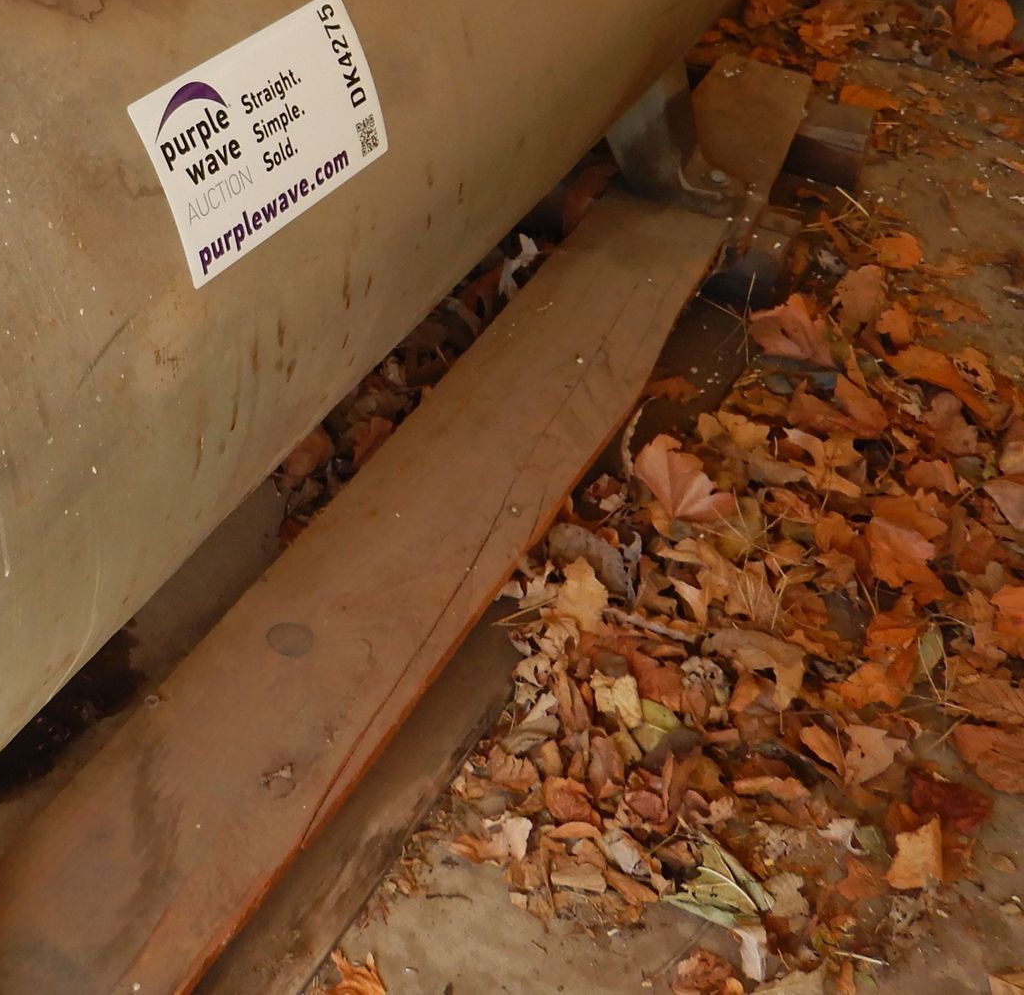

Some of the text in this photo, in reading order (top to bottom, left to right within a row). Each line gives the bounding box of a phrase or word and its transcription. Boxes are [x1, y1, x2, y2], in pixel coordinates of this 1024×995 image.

[317, 4, 367, 108] DK4275
[240, 68, 302, 115] Straight.
[159, 105, 230, 172] purple
[252, 108, 306, 143] Simple.
[185, 137, 242, 186] wave
[262, 136, 299, 173] Sold.
[187, 165, 254, 226] AUCTION
[198, 149, 350, 276] purplewave.com
